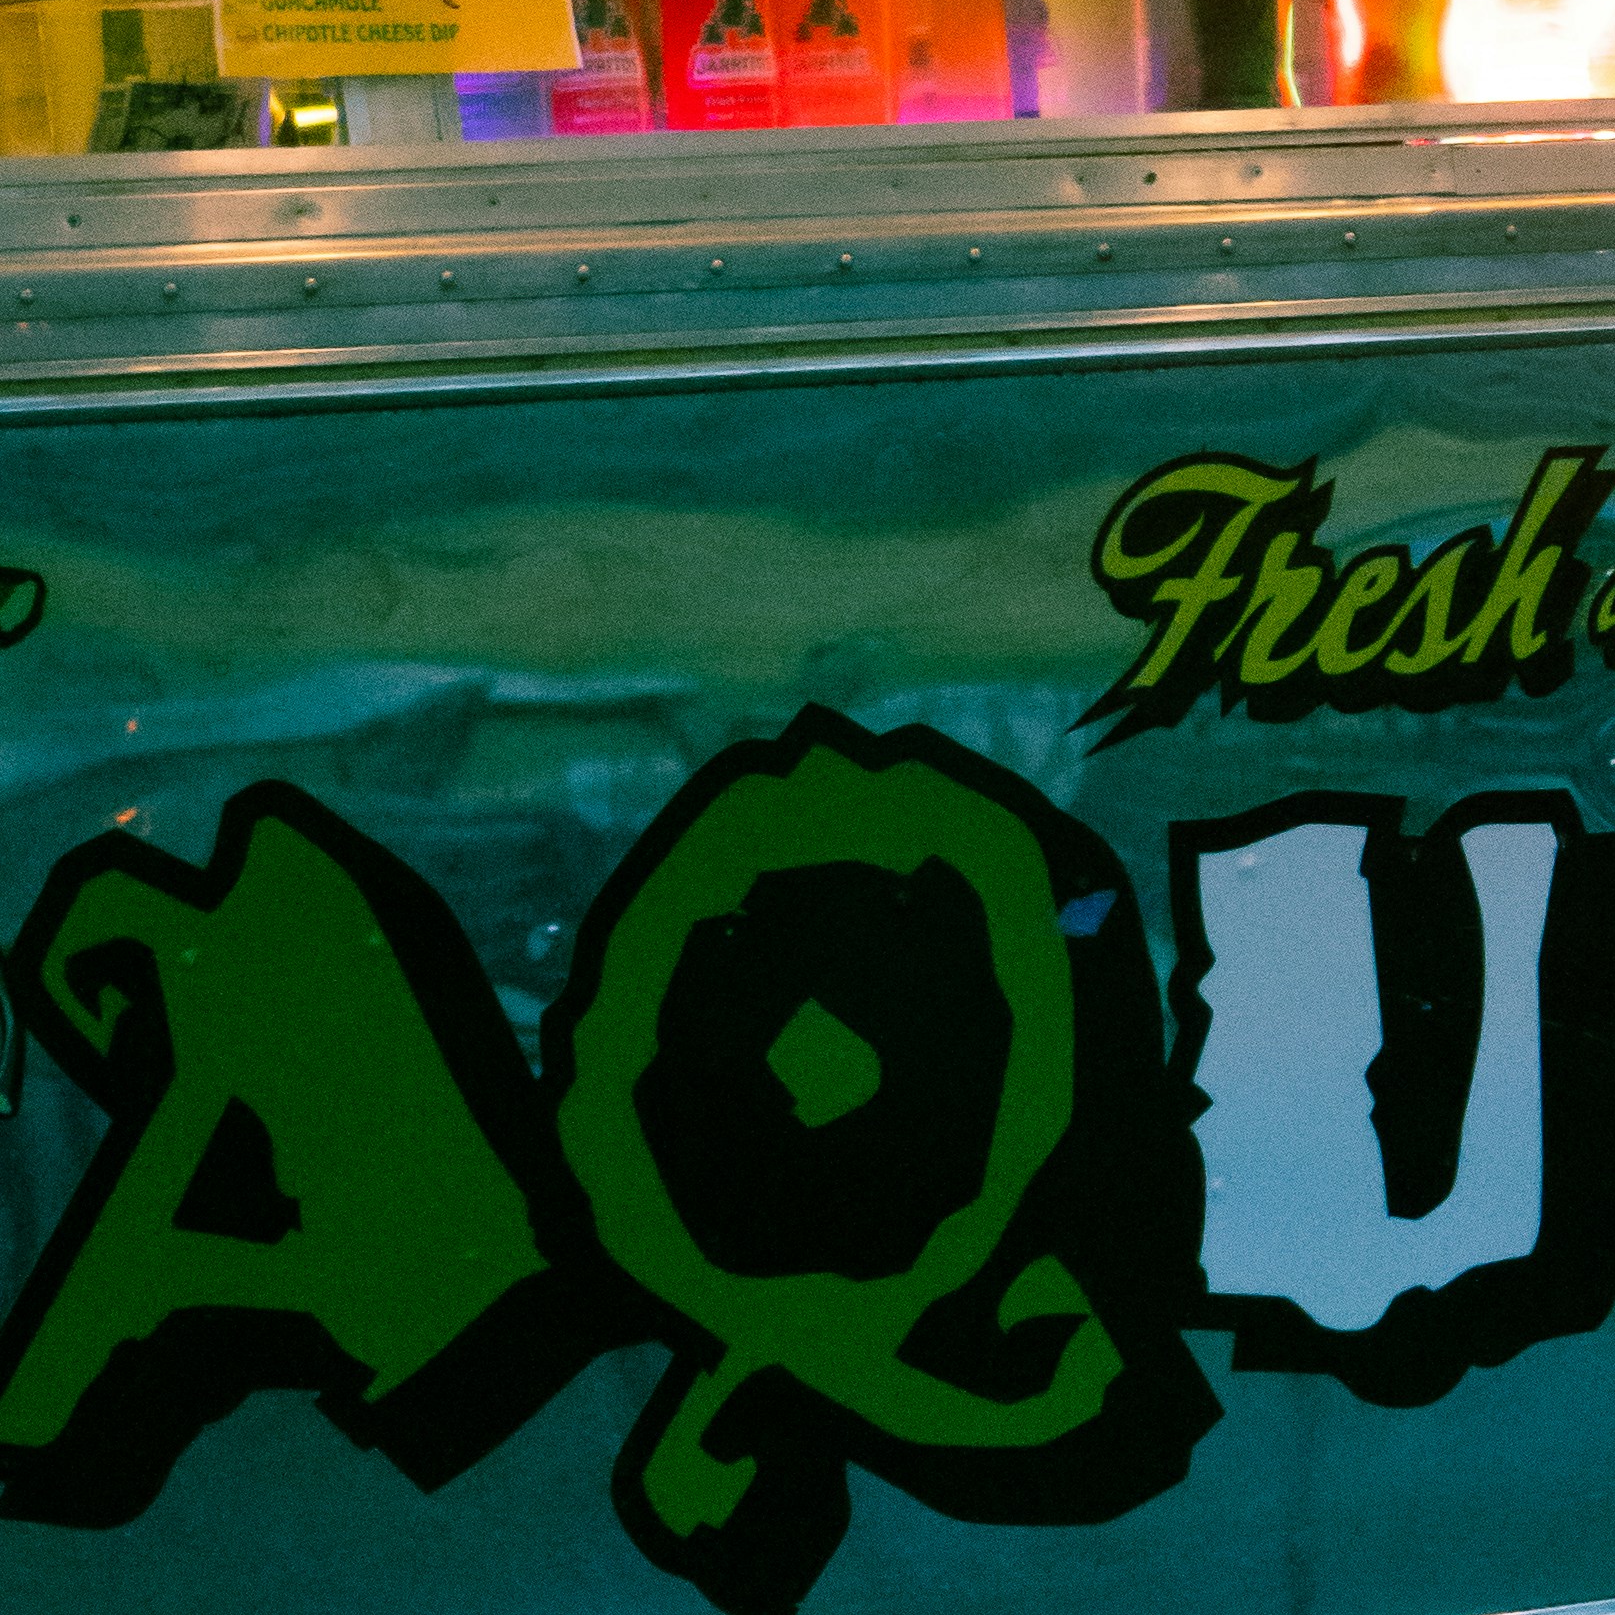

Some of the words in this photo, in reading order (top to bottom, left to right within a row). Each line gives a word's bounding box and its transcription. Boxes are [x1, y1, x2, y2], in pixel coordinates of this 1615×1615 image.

[262, 22, 351, 43] CHIPOTLE
[356, 23, 426, 43] CHEESE
[429, 23, 460, 43] DIP
[582, 53, 638, 74] RRITOS
[1085, 443, 1600, 703] Fresh
